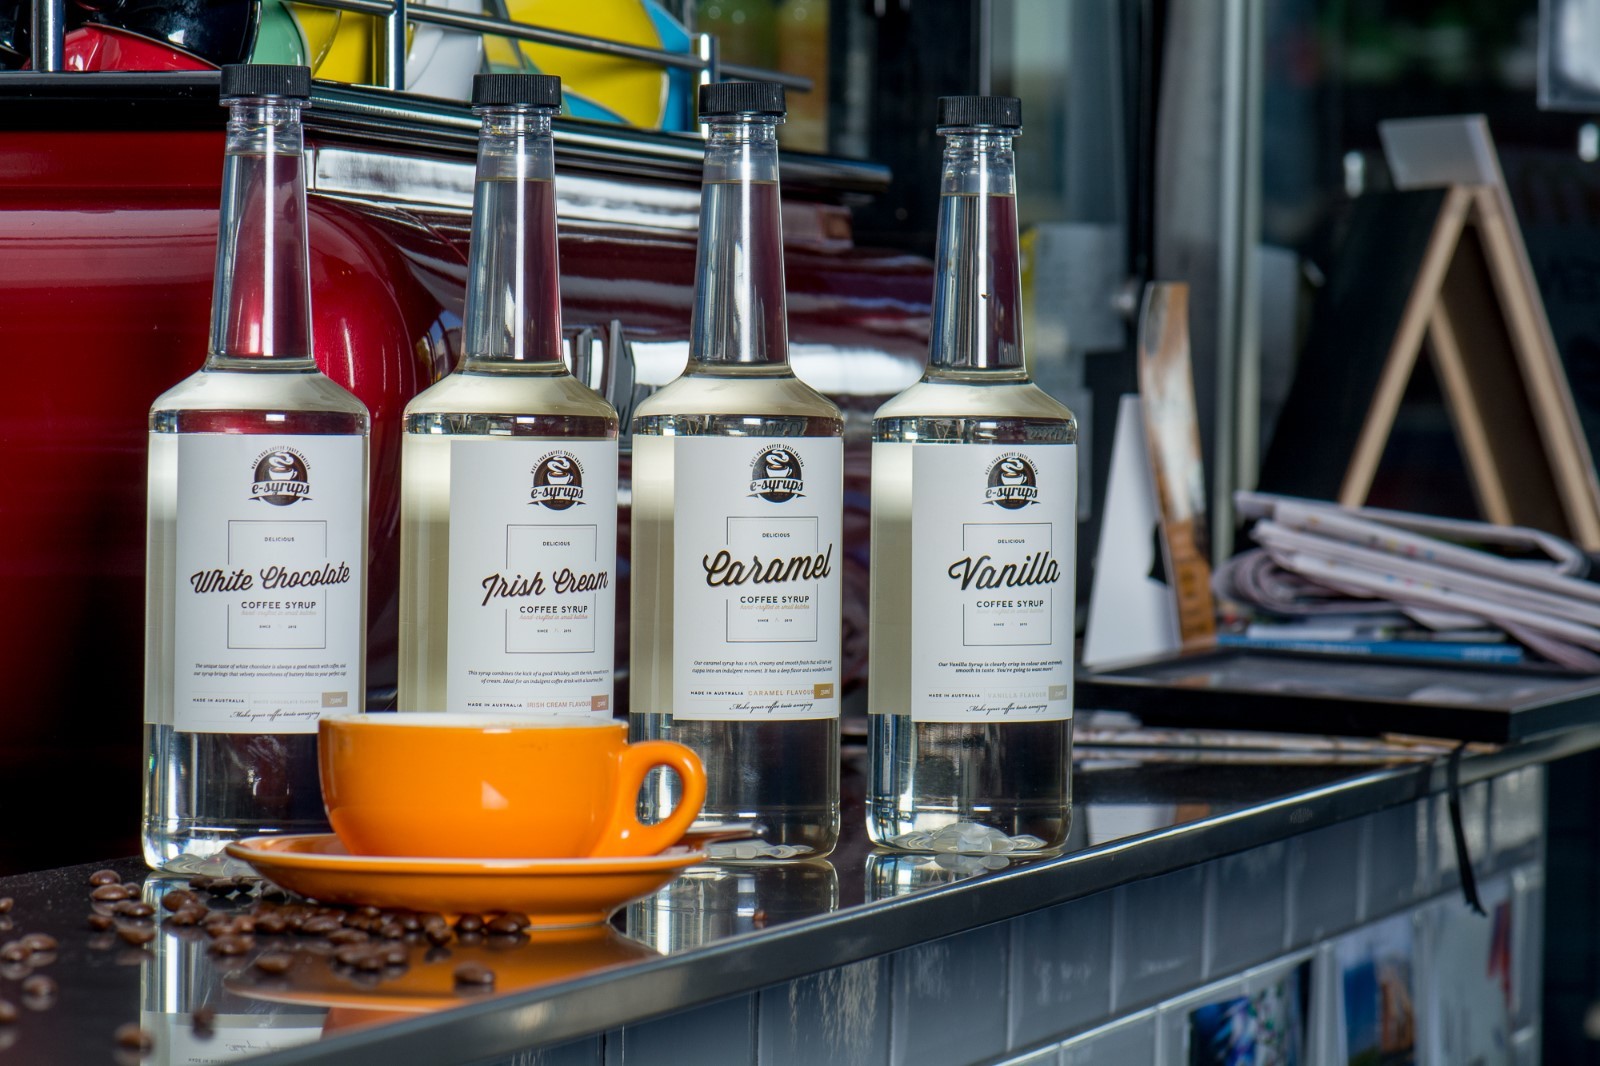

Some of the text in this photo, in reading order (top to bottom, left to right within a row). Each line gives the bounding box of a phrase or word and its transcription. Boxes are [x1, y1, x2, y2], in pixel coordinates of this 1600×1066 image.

[252, 482, 310, 496] e-syrups
[531, 486, 583, 500] e-syrups
[750, 480, 804, 493] e-syrups
[986, 488, 1038, 500] e-syrups
[702, 543, 832, 587] Caramel
[948, 551, 1060, 590] Vanilla
[190, 561, 350, 593] White Chocolate
[482, 568, 608, 606] Irish Cream
[729, 702, 750, 710] Make
[750, 706, 764, 714] your
[765, 701, 779, 713] coffee
[793, 702, 813, 711] amazing
[1001, 702, 1015, 715] coffee
[1028, 704, 1047, 713] amazing
[230, 709, 251, 718] Make
[251, 714, 266, 722] your
